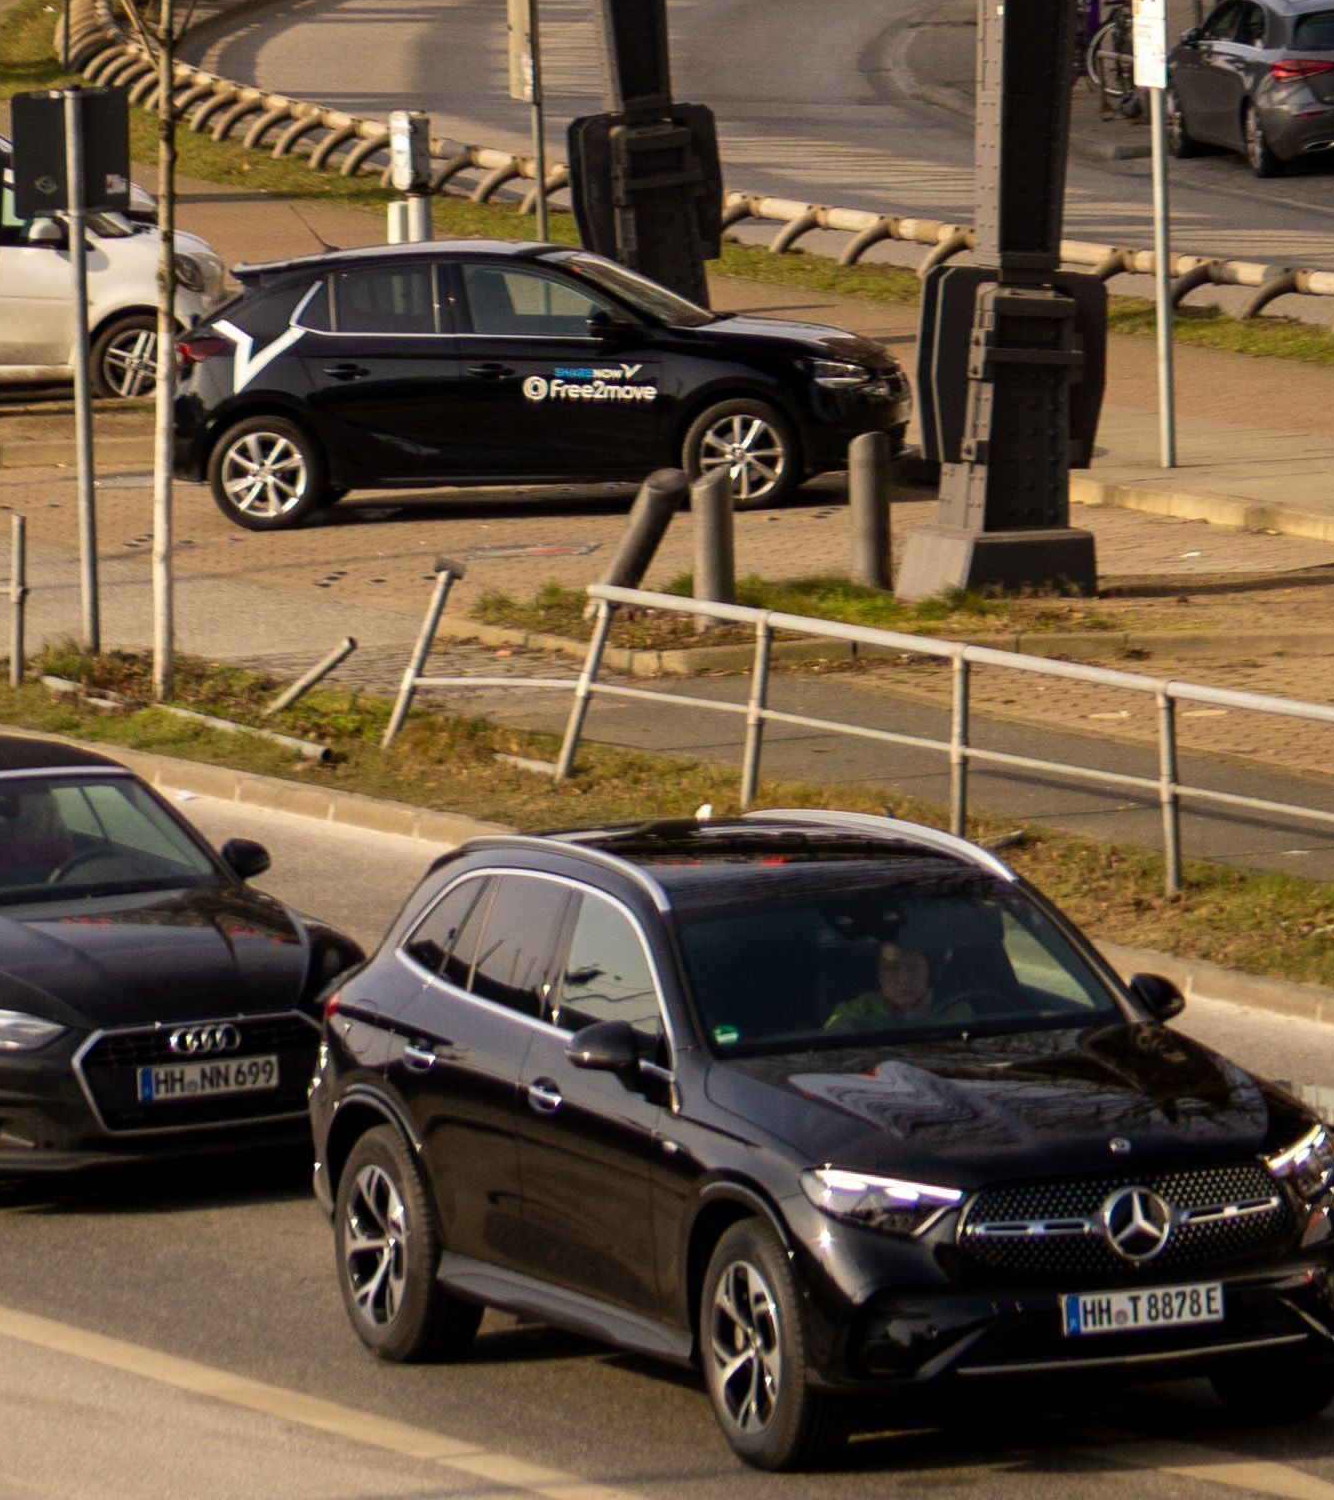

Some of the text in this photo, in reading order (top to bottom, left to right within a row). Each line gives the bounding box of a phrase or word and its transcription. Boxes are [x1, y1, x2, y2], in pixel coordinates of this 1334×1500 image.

[549, 380, 658, 401] Free2move
[154, 1058, 275, 1095] HH NN 699
[1082, 1297, 1113, 1328] HH
[1128, 1295, 1142, 1324] T
